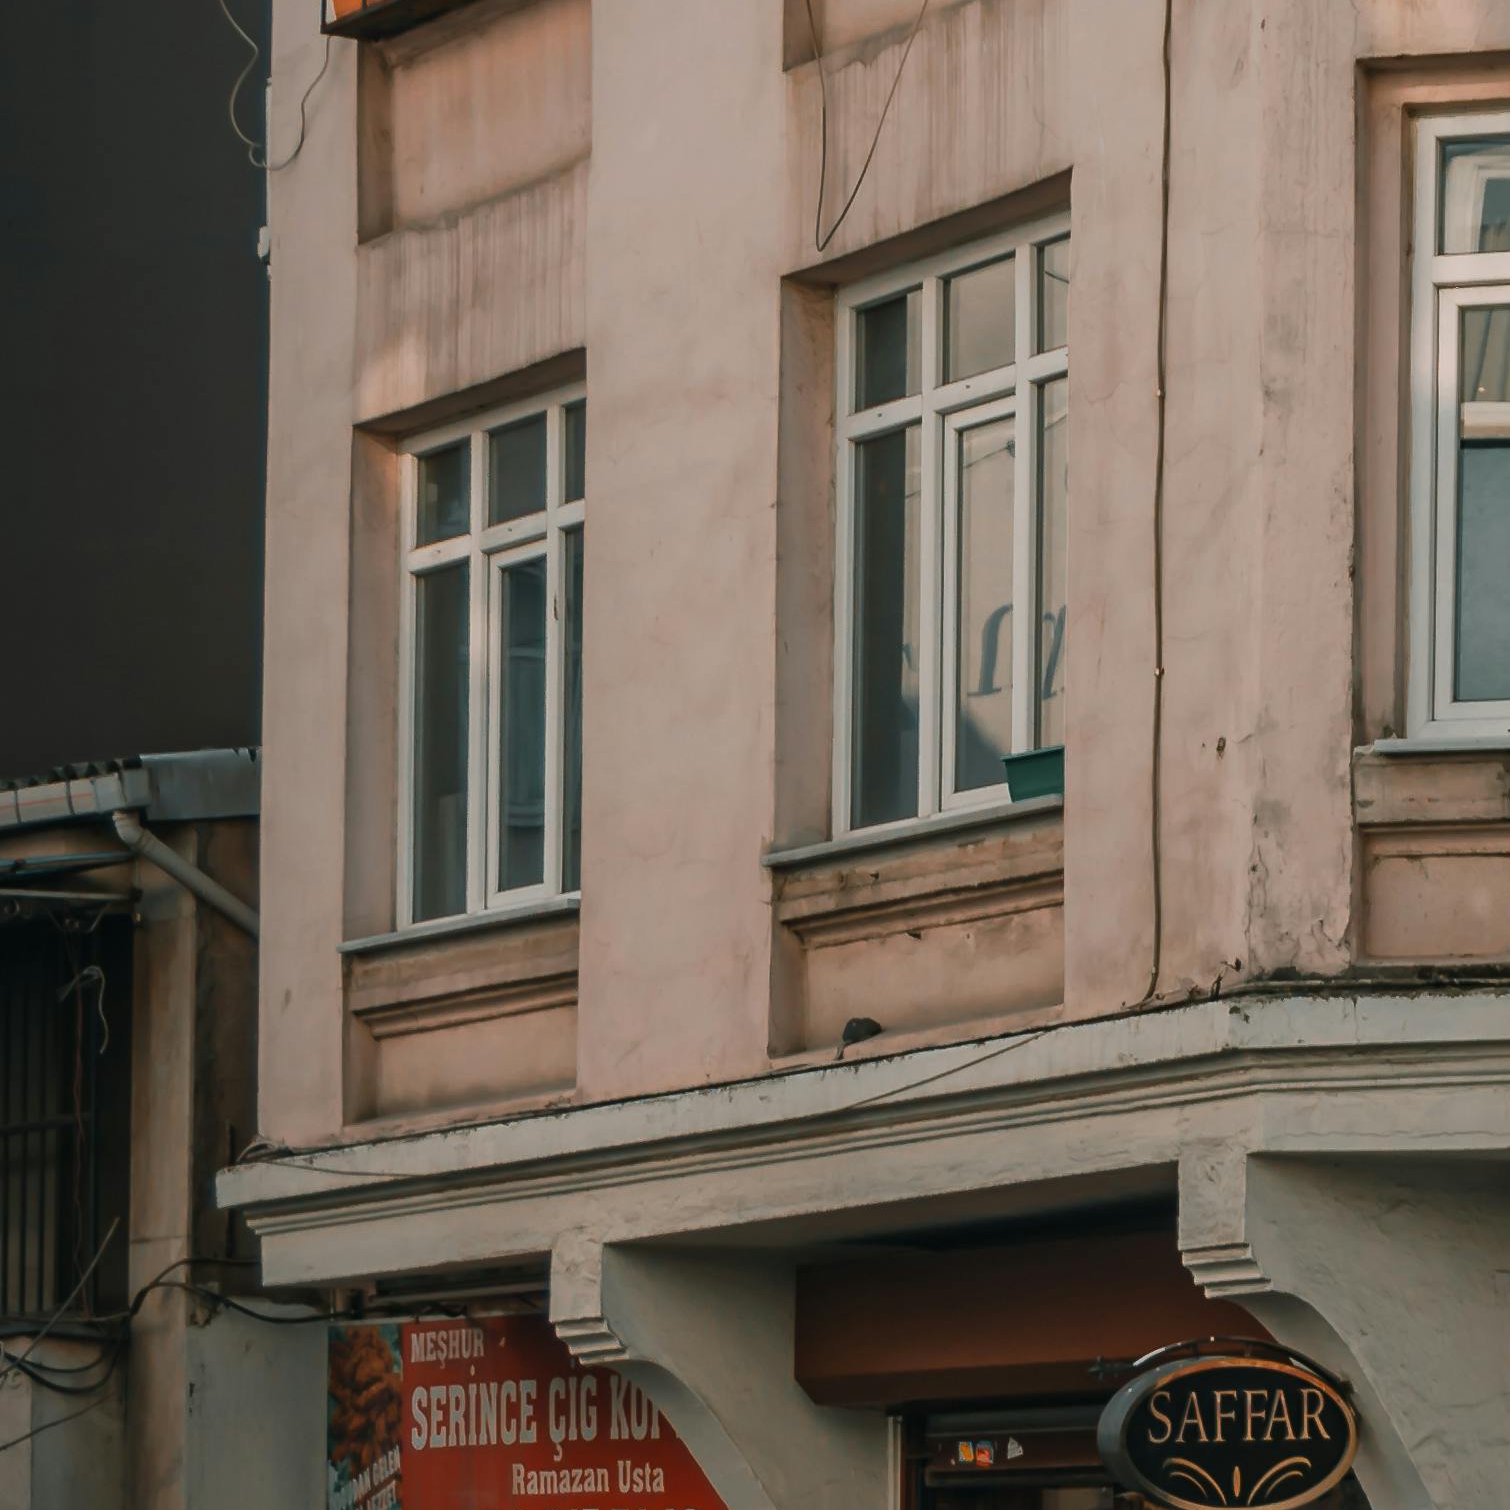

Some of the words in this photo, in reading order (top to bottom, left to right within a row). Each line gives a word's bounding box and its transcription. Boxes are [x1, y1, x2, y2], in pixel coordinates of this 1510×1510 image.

[411, 1327, 485, 1368] MEŞHUR
[411, 1364, 538, 1451] SERİNCE
[1148, 1388, 1332, 1445] SAFFAR
[511, 1463, 610, 1497] Ramazan
[617, 1459, 665, 1494] Usta
